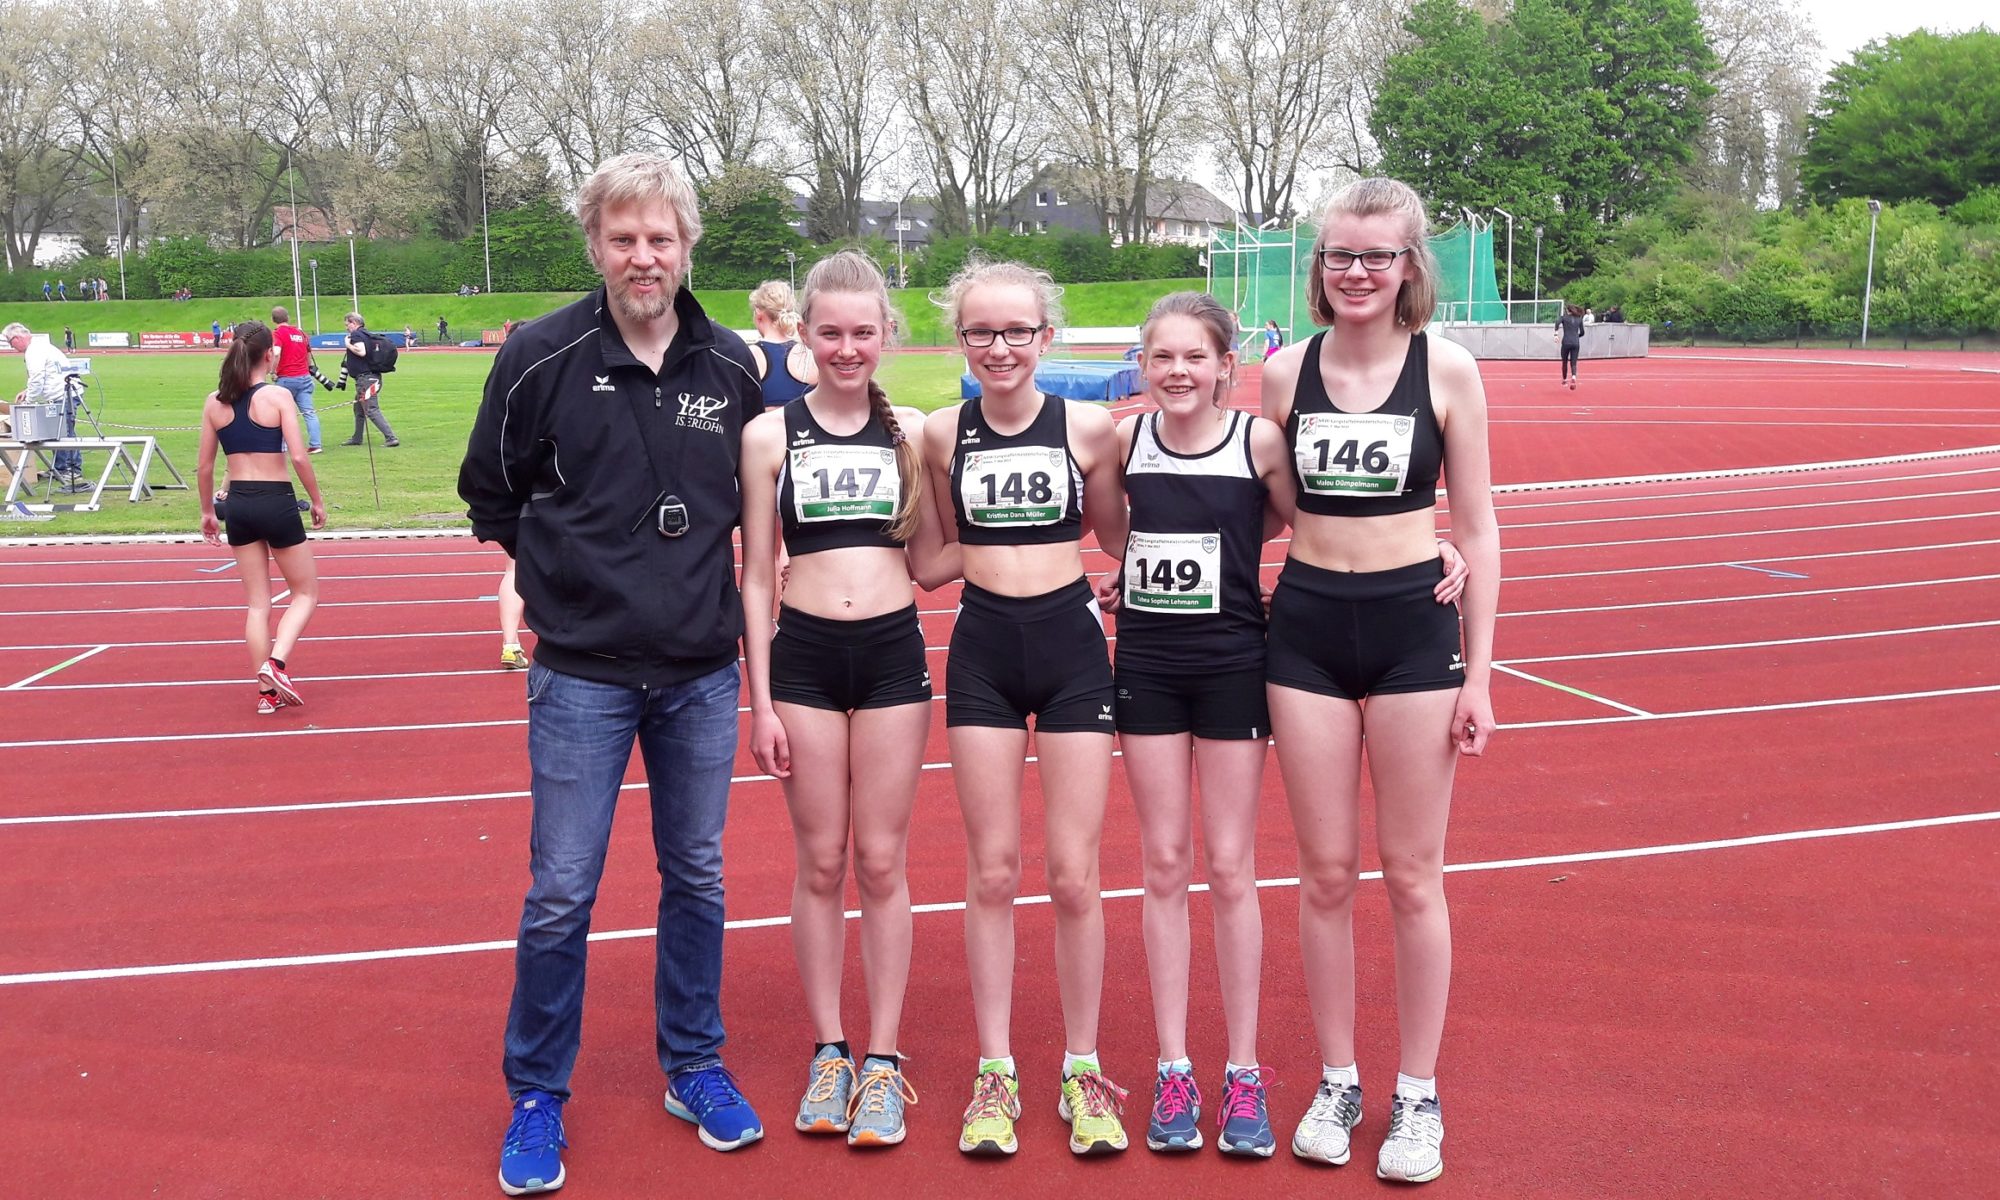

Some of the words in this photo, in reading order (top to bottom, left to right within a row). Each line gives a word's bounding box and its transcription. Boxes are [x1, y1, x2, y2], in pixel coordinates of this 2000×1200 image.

[1313, 439, 1390, 475] 146
[812, 467, 882, 499] 147
[980, 471, 1053, 506] 148
[1335, 479, 1380, 488] Dümpelmann
[841, 504, 872, 512] Hoffmann
[1025, 510, 1046, 518] Müller
[1136, 557, 1202, 593] 149
[1170, 598, 1200, 606] Lehmann
